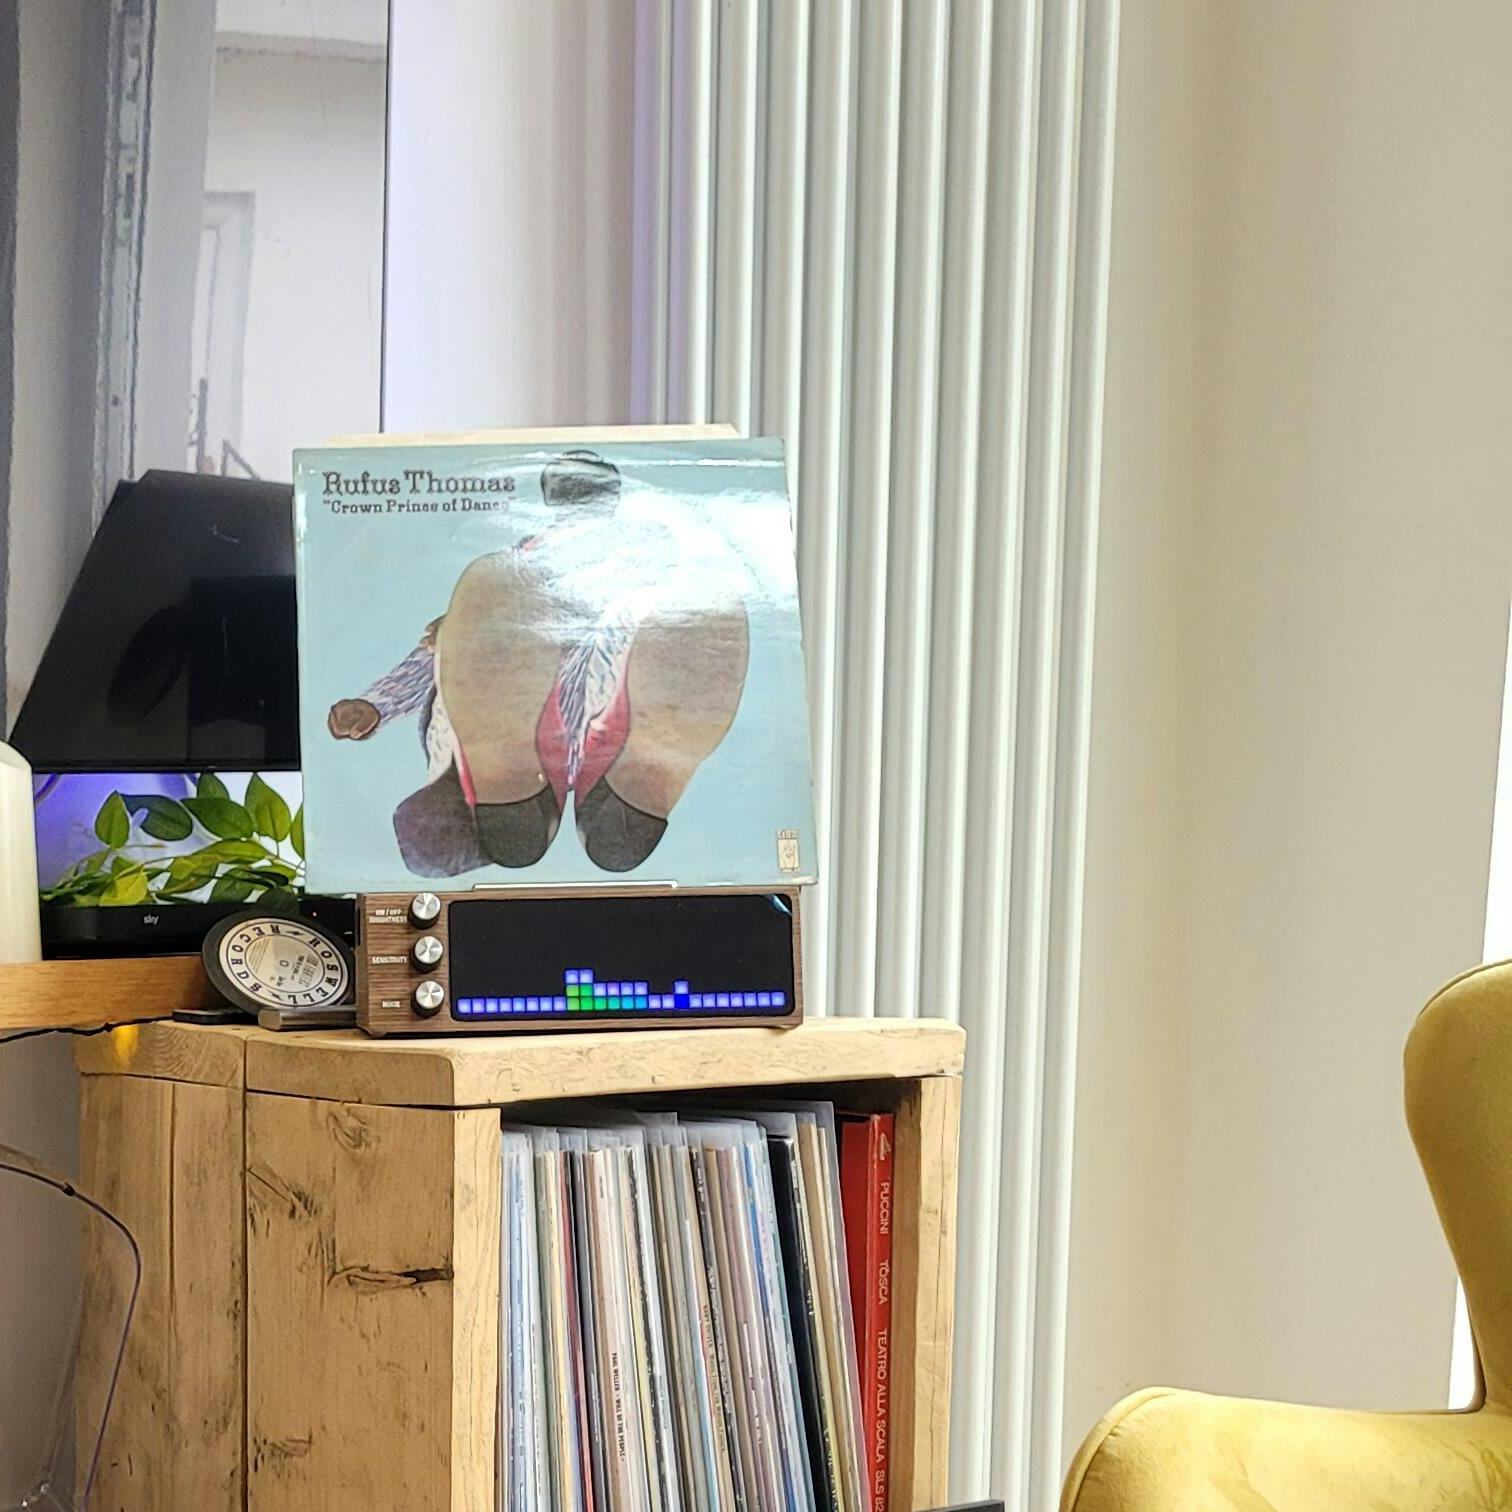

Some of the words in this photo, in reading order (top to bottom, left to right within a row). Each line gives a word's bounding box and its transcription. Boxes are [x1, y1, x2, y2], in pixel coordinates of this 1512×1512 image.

[322, 469, 401, 496] Rufus
[404, 469, 516, 495] Thomas
[441, 497, 458, 512] of
[143, 914, 159, 926] sky
[879, 1182, 890, 1235] PUCCINI
[878, 1260, 888, 1306] TOSCA
[877, 1327, 887, 1382] TEATRO
[876, 1385, 886, 1418] ALLA
[875, 1419, 886, 1463] SCALA
[874, 1469, 885, 1494] SLS
